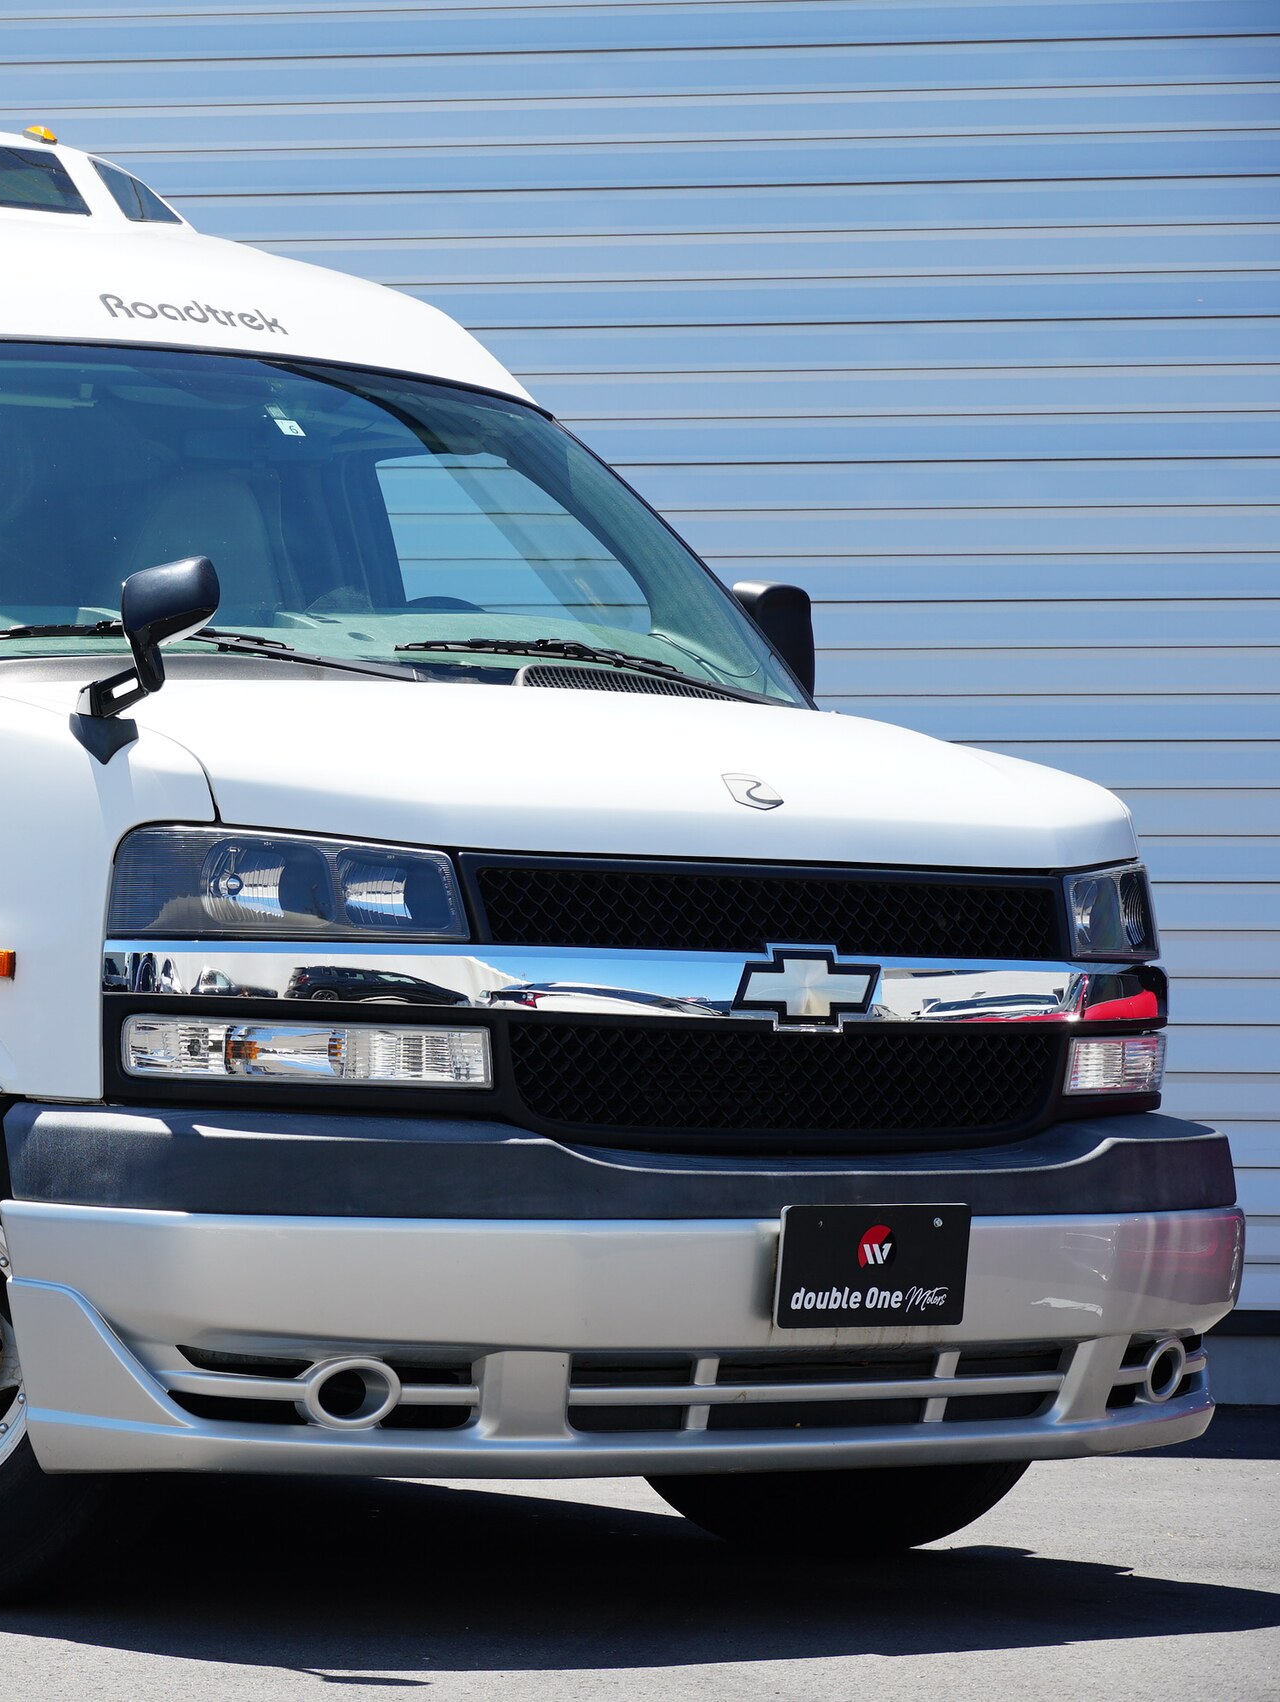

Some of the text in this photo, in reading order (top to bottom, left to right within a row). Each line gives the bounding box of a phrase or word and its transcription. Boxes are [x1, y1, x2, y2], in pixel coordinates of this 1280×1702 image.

[99, 293, 289, 335] Roadtrek
[288, 425, 299, 434] 6
[790, 1285, 949, 1312] double One Motors
